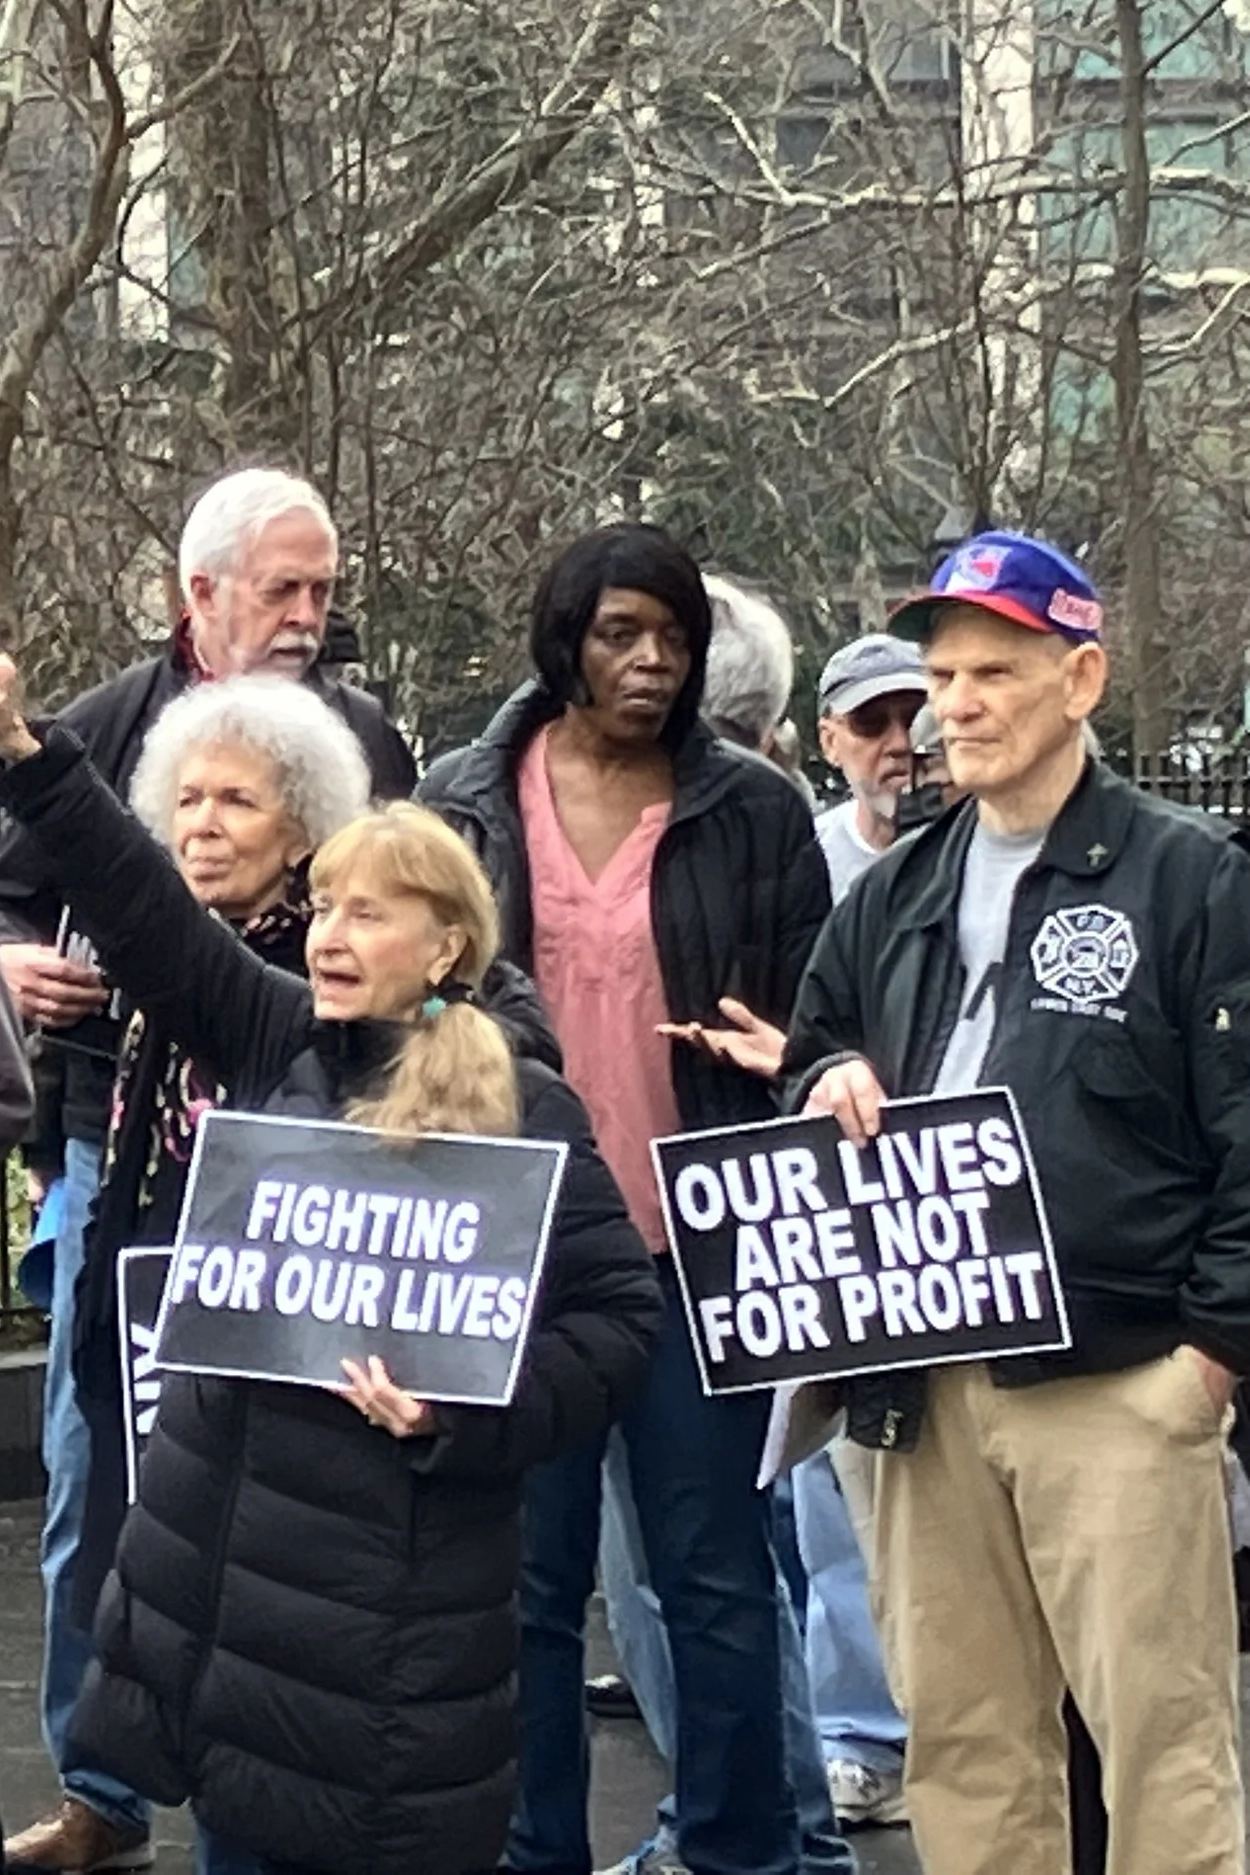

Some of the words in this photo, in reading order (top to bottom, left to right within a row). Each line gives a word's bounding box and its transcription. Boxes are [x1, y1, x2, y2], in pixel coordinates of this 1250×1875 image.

[246, 1180, 480, 1263] FIGHTING
[675, 1147, 828, 1231] OUR
[837, 1117, 1022, 1206] LIVES
[735, 1209, 861, 1291] ARE
[871, 1191, 990, 1268] NOT
[171, 1245, 266, 1311] FOR
[275, 1256, 384, 1328] OUR
[391, 1269, 527, 1340] LIVES
[699, 1290, 830, 1363] FOR
[839, 1252, 1042, 1343] PROFIT
